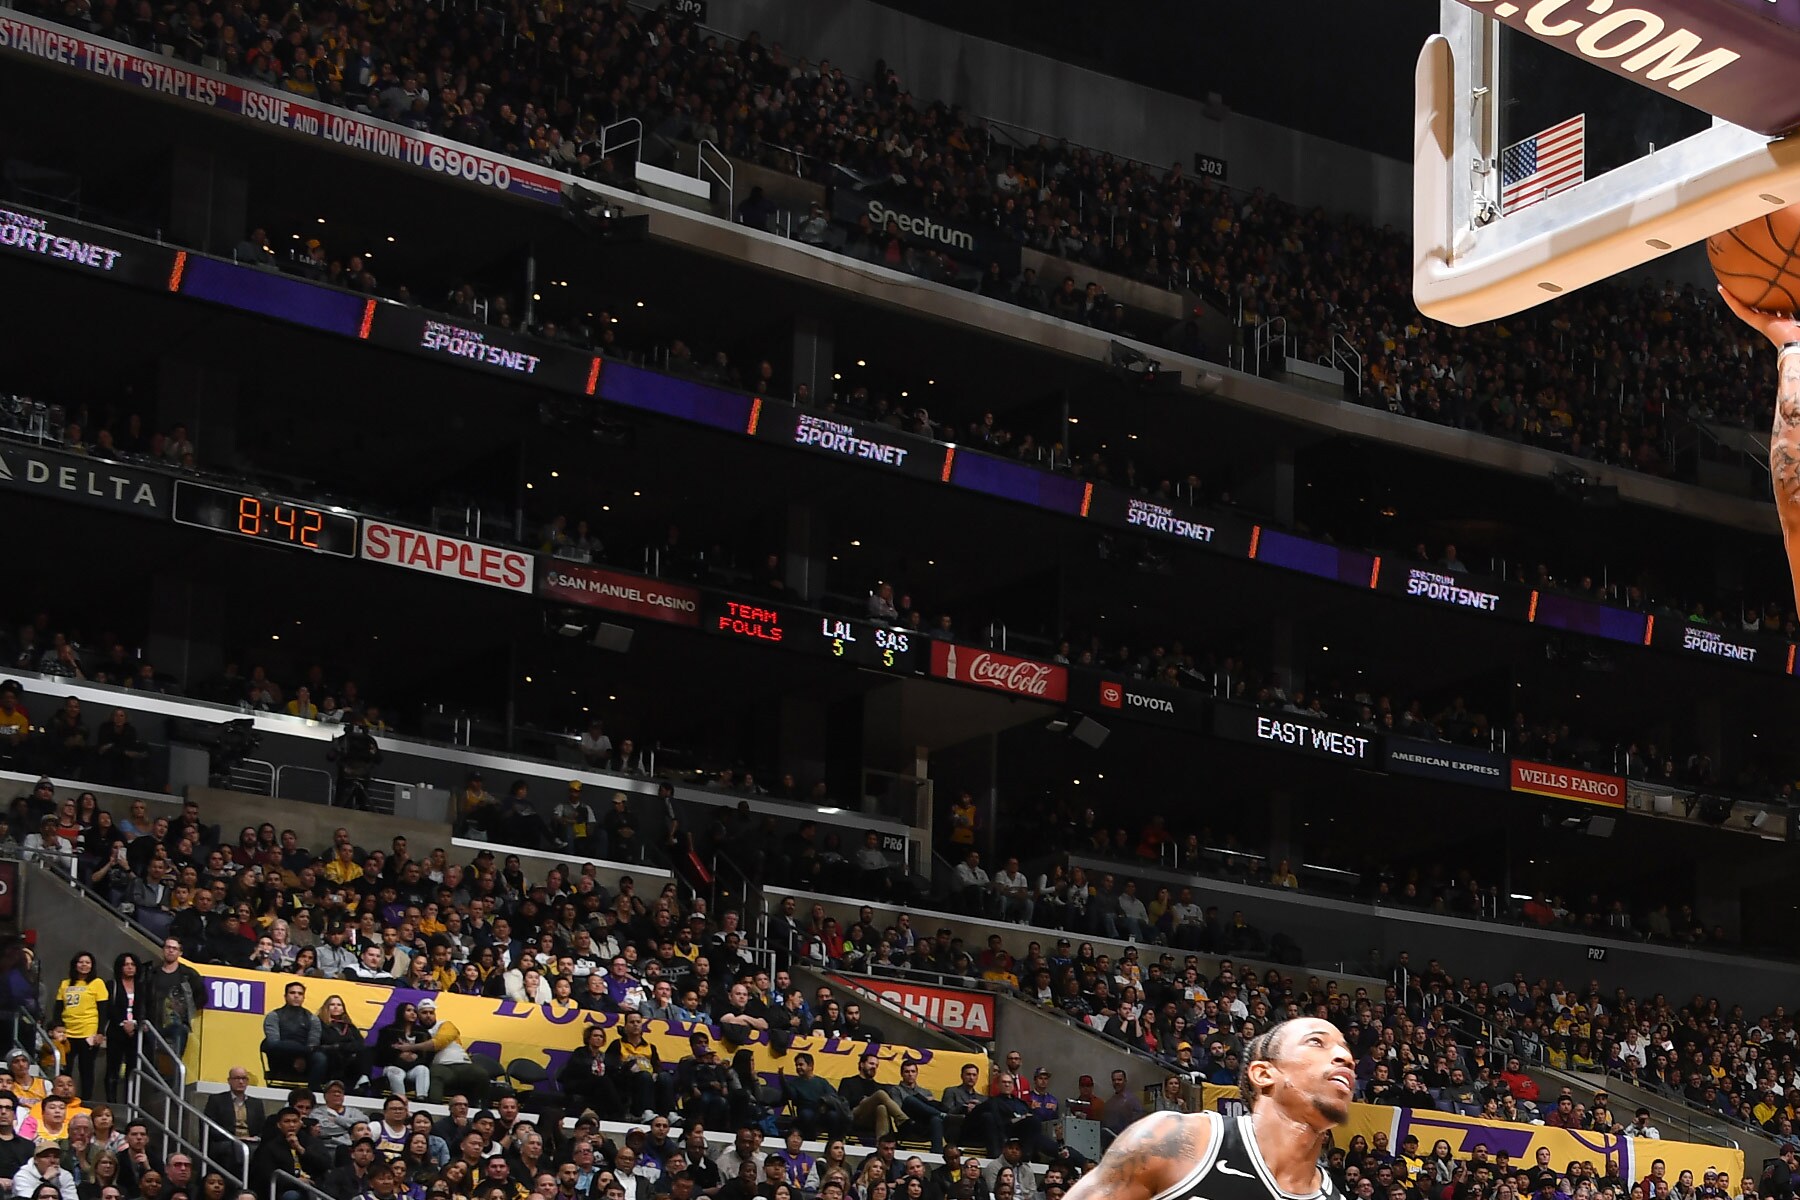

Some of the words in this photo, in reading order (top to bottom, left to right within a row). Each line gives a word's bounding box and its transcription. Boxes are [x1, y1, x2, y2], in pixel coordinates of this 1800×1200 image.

[1468, 0, 1741, 91] .COM
[84, 43, 128, 80] TEXT
[241, 89, 289, 128] ISSUE
[293, 112, 318, 136] AND
[323, 114, 400, 159] LOCATION
[404, 137, 424, 165] TO
[428, 146, 511, 190] 69050
[1200, 159, 1222, 175] 303
[868, 199, 974, 251] Spectrum
[421, 330, 540, 374] SPORTSNET
[794, 424, 908, 466] SPORTSNET
[26, 459, 157, 507] DELTA
[1127, 508, 1215, 542] SPORTSNET
[366, 523, 528, 588] STAPLES
[558, 574, 587, 588] SAN
[590, 578, 644, 602] MANUEL
[647, 592, 696, 613] CASINO
[1406, 578, 1500, 611] SPORTSNET
[727, 602, 777, 624] TEAM
[719, 616, 783, 641] FOULS
[823, 618, 856, 642] LAL
[875, 629, 909, 652] SAS
[833, 639, 844, 656] 5
[883, 649, 894, 666] 5
[1682, 635, 1757, 662] SPORTSNET
[1125, 693, 1174, 713] TOYOTA
[1257, 716, 1309, 746] EAST
[1311, 728, 1369, 758] WEST
[1391, 751, 1449, 768] AMERICAN
[1452, 762, 1500, 776] EXPRESS
[1519, 768, 1569, 789] WELLS
[1570, 778, 1619, 797] FARGO
[882, 836, 903, 851] PR6
[1588, 947, 1605, 961] PR7
[66, 993, 80, 1006] 23
[211, 981, 251, 1010] 101
[846, 985, 990, 1033] SHIBA
